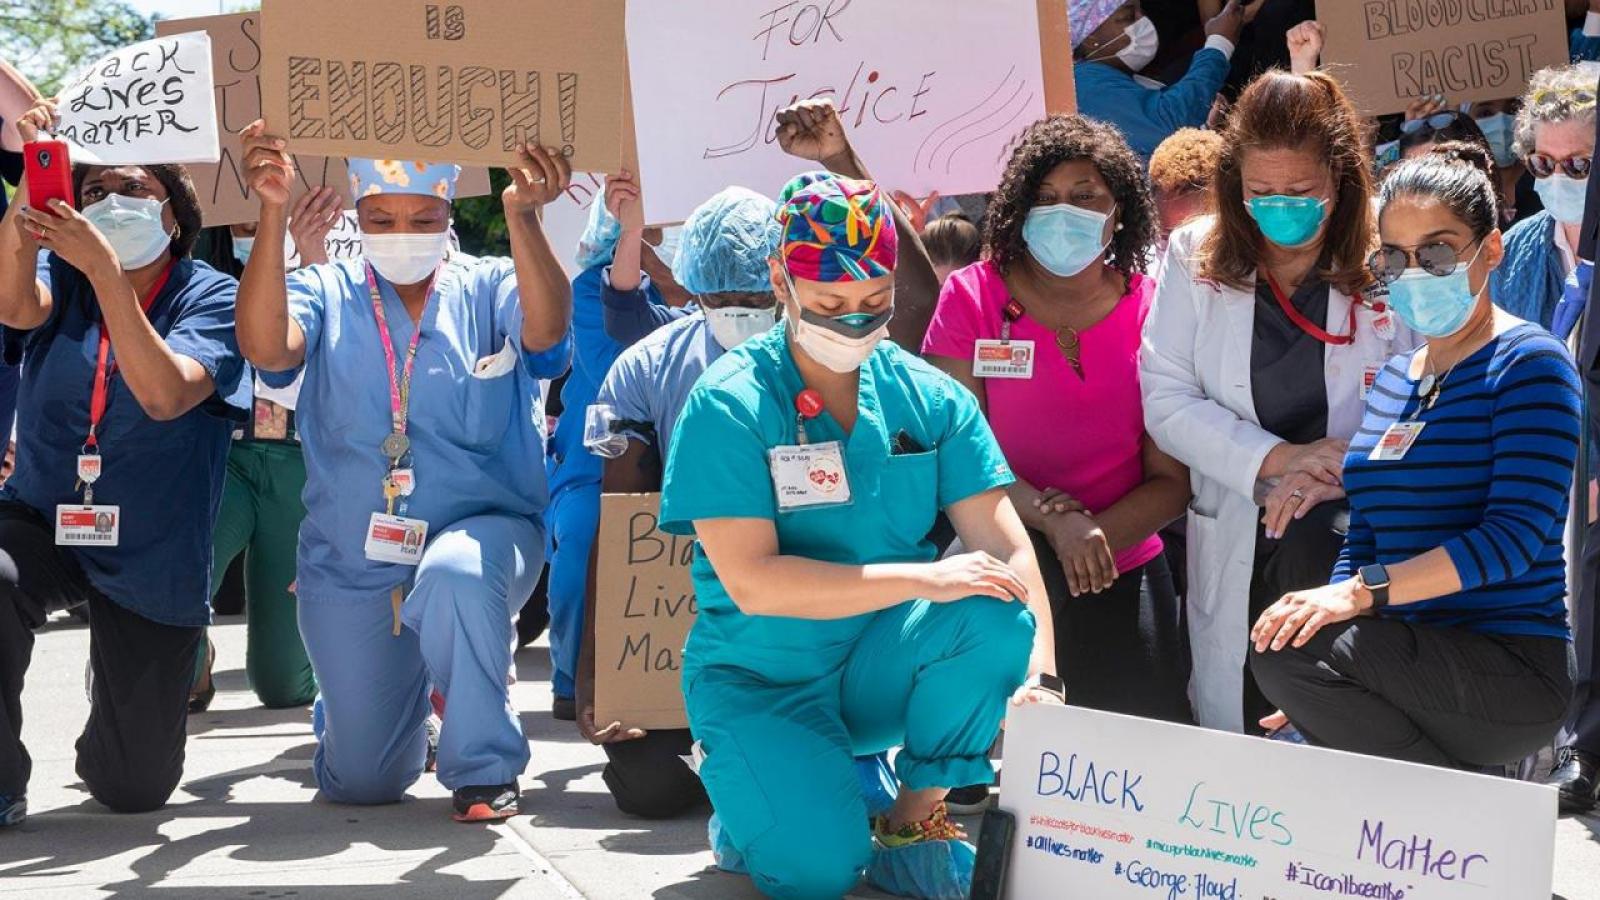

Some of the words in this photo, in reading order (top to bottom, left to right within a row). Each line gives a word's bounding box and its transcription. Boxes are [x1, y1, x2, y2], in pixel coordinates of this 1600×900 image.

[425, 4, 466, 41] IS
[753, 0, 851, 61] FOR
[1392, 33, 1538, 98] RACIST
[288, 56, 578, 157] ENOUGH!
[627, 511, 695, 566] Bla
[1037, 751, 1144, 812] BLACK
[1356, 819, 1488, 880] Matter
